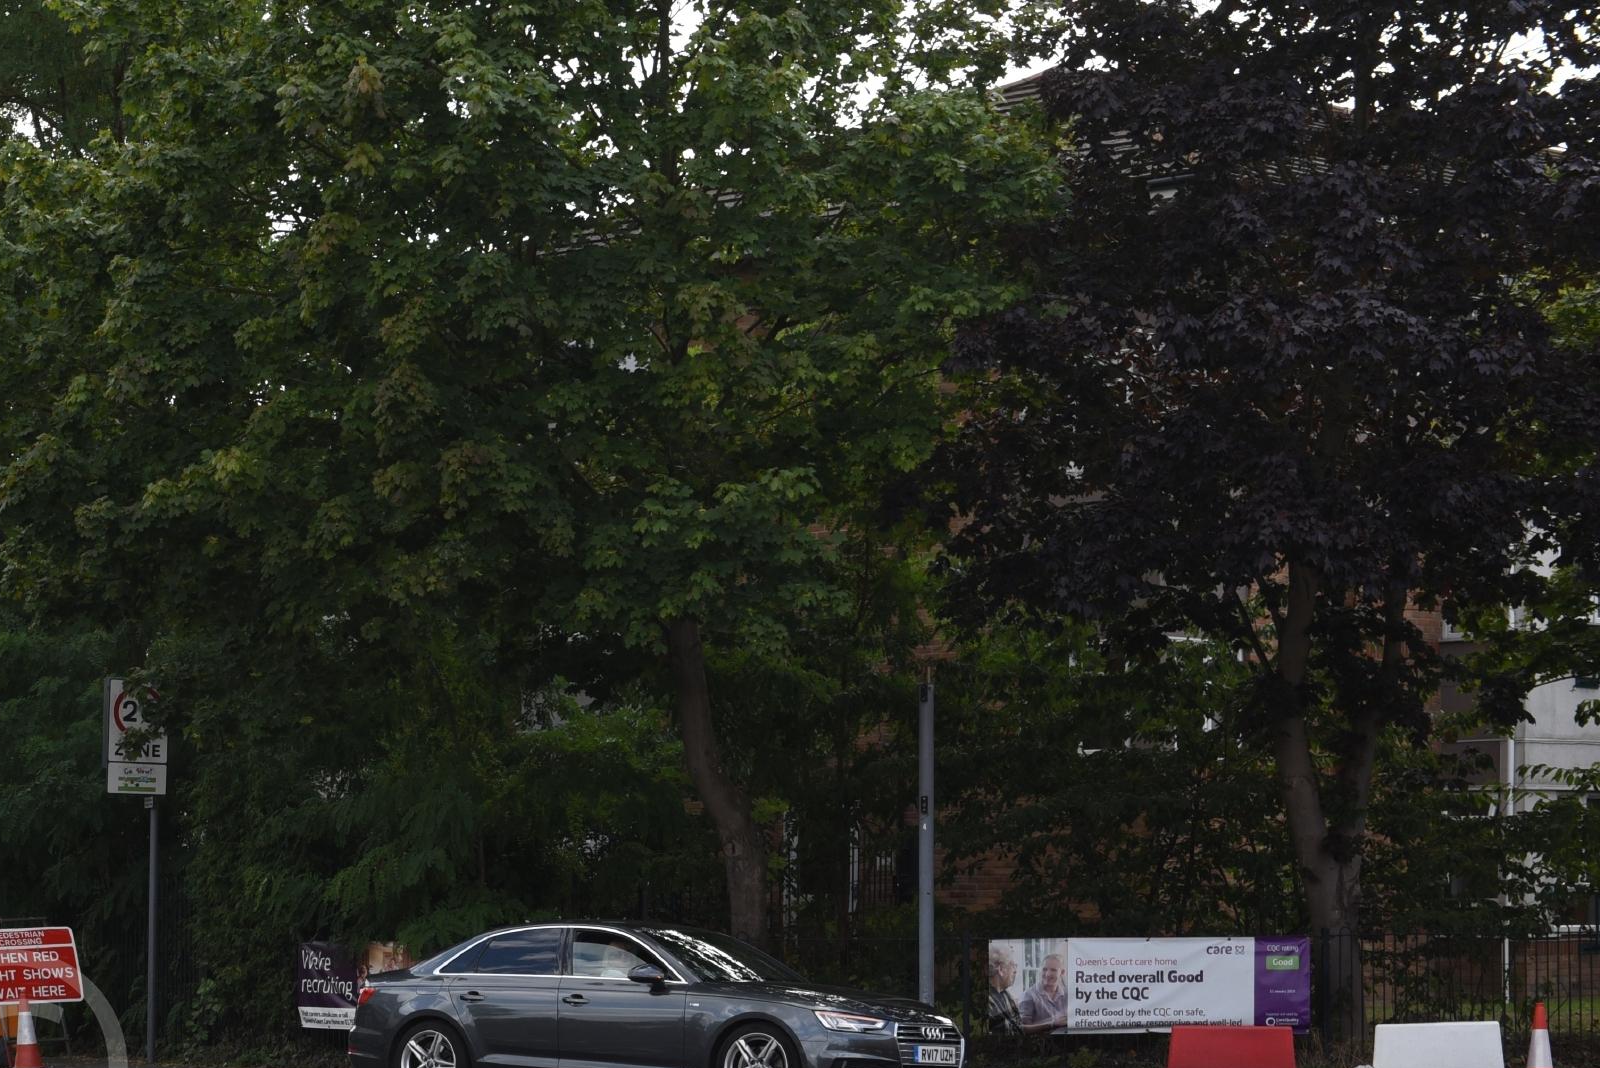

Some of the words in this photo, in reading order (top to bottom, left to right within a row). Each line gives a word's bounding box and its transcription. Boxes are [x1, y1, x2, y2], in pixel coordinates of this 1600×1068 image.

[114, 742, 161, 758] ZNE
[1206, 945, 1234, 955] care
[1266, 944, 1281, 953] CQC
[32, 951, 59, 962] RED
[302, 949, 331, 971] We're
[1075, 957, 1108, 967] Queen's
[1109, 957, 1133, 966] Court
[1134, 958, 1153, 966] care
[1154, 957, 1178, 966] home
[1272, 958, 1294, 966] Good
[23, 967, 74, 980] SHOWS
[1075, 970, 1116, 984] Rated
[1118, 970, 1165, 984] overall
[1167, 970, 1204, 984] Good
[32, 985, 67, 998] HERE
[301, 975, 353, 1001] recruiting
[1075, 987, 1092, 1003] by
[1095, 987, 1118, 1000] the
[1121, 986, 1150, 1002] CQC
[1075, 1008, 1100, 1017] Rated
[1101, 1008, 1124, 1017] Good
[1125, 1008, 1136, 1018] by
[1138, 1008, 1152, 1017] the
[1153, 1008, 1171, 1017] CQC
[1185, 1008, 1206, 1017] safe,
